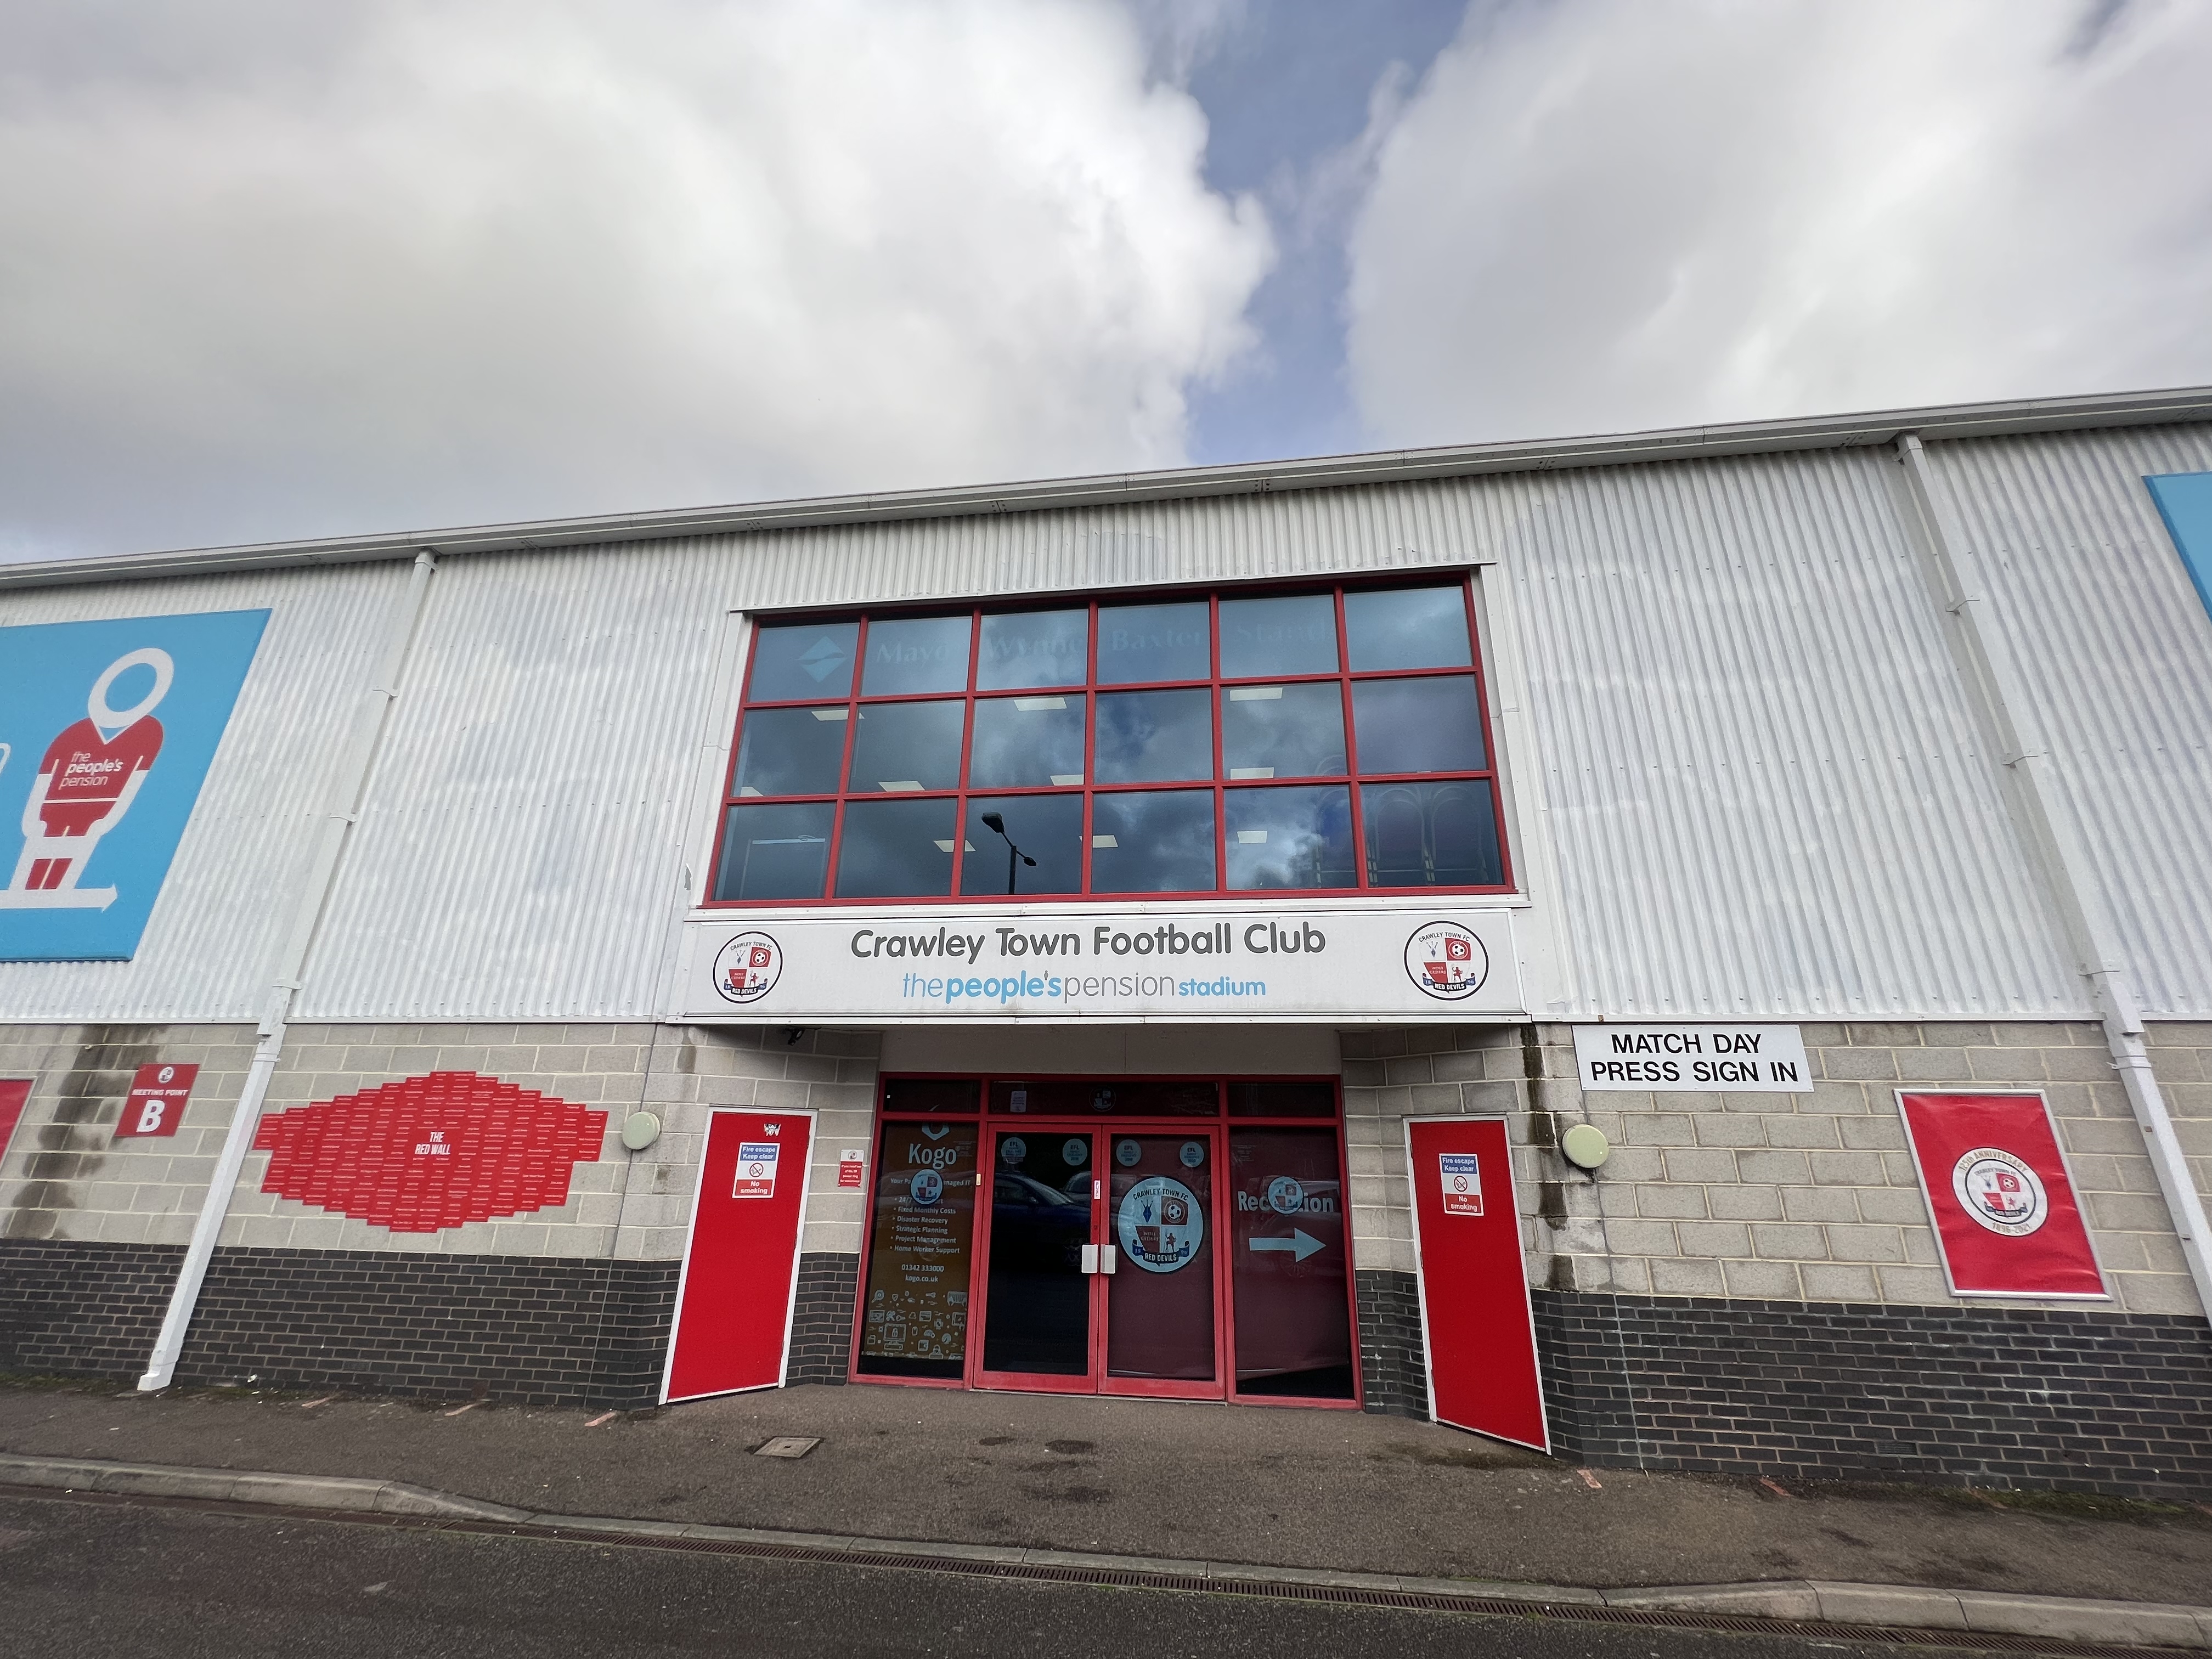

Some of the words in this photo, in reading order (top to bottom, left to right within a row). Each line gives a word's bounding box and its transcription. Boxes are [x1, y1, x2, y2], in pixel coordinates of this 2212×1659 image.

[877, 642, 949, 668] Mayo
[1111, 628, 1201, 651] Baxter
[71, 751, 91, 763] the
[64, 759, 123, 776] people's
[58, 776, 108, 790] pension
[851, 926, 985, 965] Crawley
[995, 928, 1080, 956] Town
[1094, 923, 1231, 955] Football
[1244, 921, 1326, 953] Club
[1418, 932, 1443, 942] CRAWLEY
[730, 941, 752, 951] CRAWLEY
[1611, 1034, 1702, 1053] MATCH
[1713, 1034, 1762, 1053] DAY
[1591, 1061, 1680, 1082] PRESS
[1693, 1061, 1760, 1082] SIGN
[1770, 1062, 1799, 1082] IN
[136, 1099, 165, 1132] B
[430, 1132, 445, 1143] THE
[415, 1144, 431, 1155] RED
[431, 1144, 451, 1155] WALL
[909, 1143, 957, 1170] Kogo
[1973, 1150, 2028, 1172] ANNIVERSARY
[1132, 1188, 1160, 1200] CRAWLEY
[1162, 1188, 1180, 1198] TOWN
[1237, 1191, 1334, 1212] Recion
[1451, 1203, 1477, 1212] smoking
[921, 1216, 948, 1224] Recovery
[896, 1225, 921, 1233] Strategic
[922, 1226, 948, 1234] Planning
[1144, 1253, 1156, 1261] RED
[1157, 1254, 1177, 1262] DEVILS
[905, 1274, 939, 1283] kogo.co.uk
